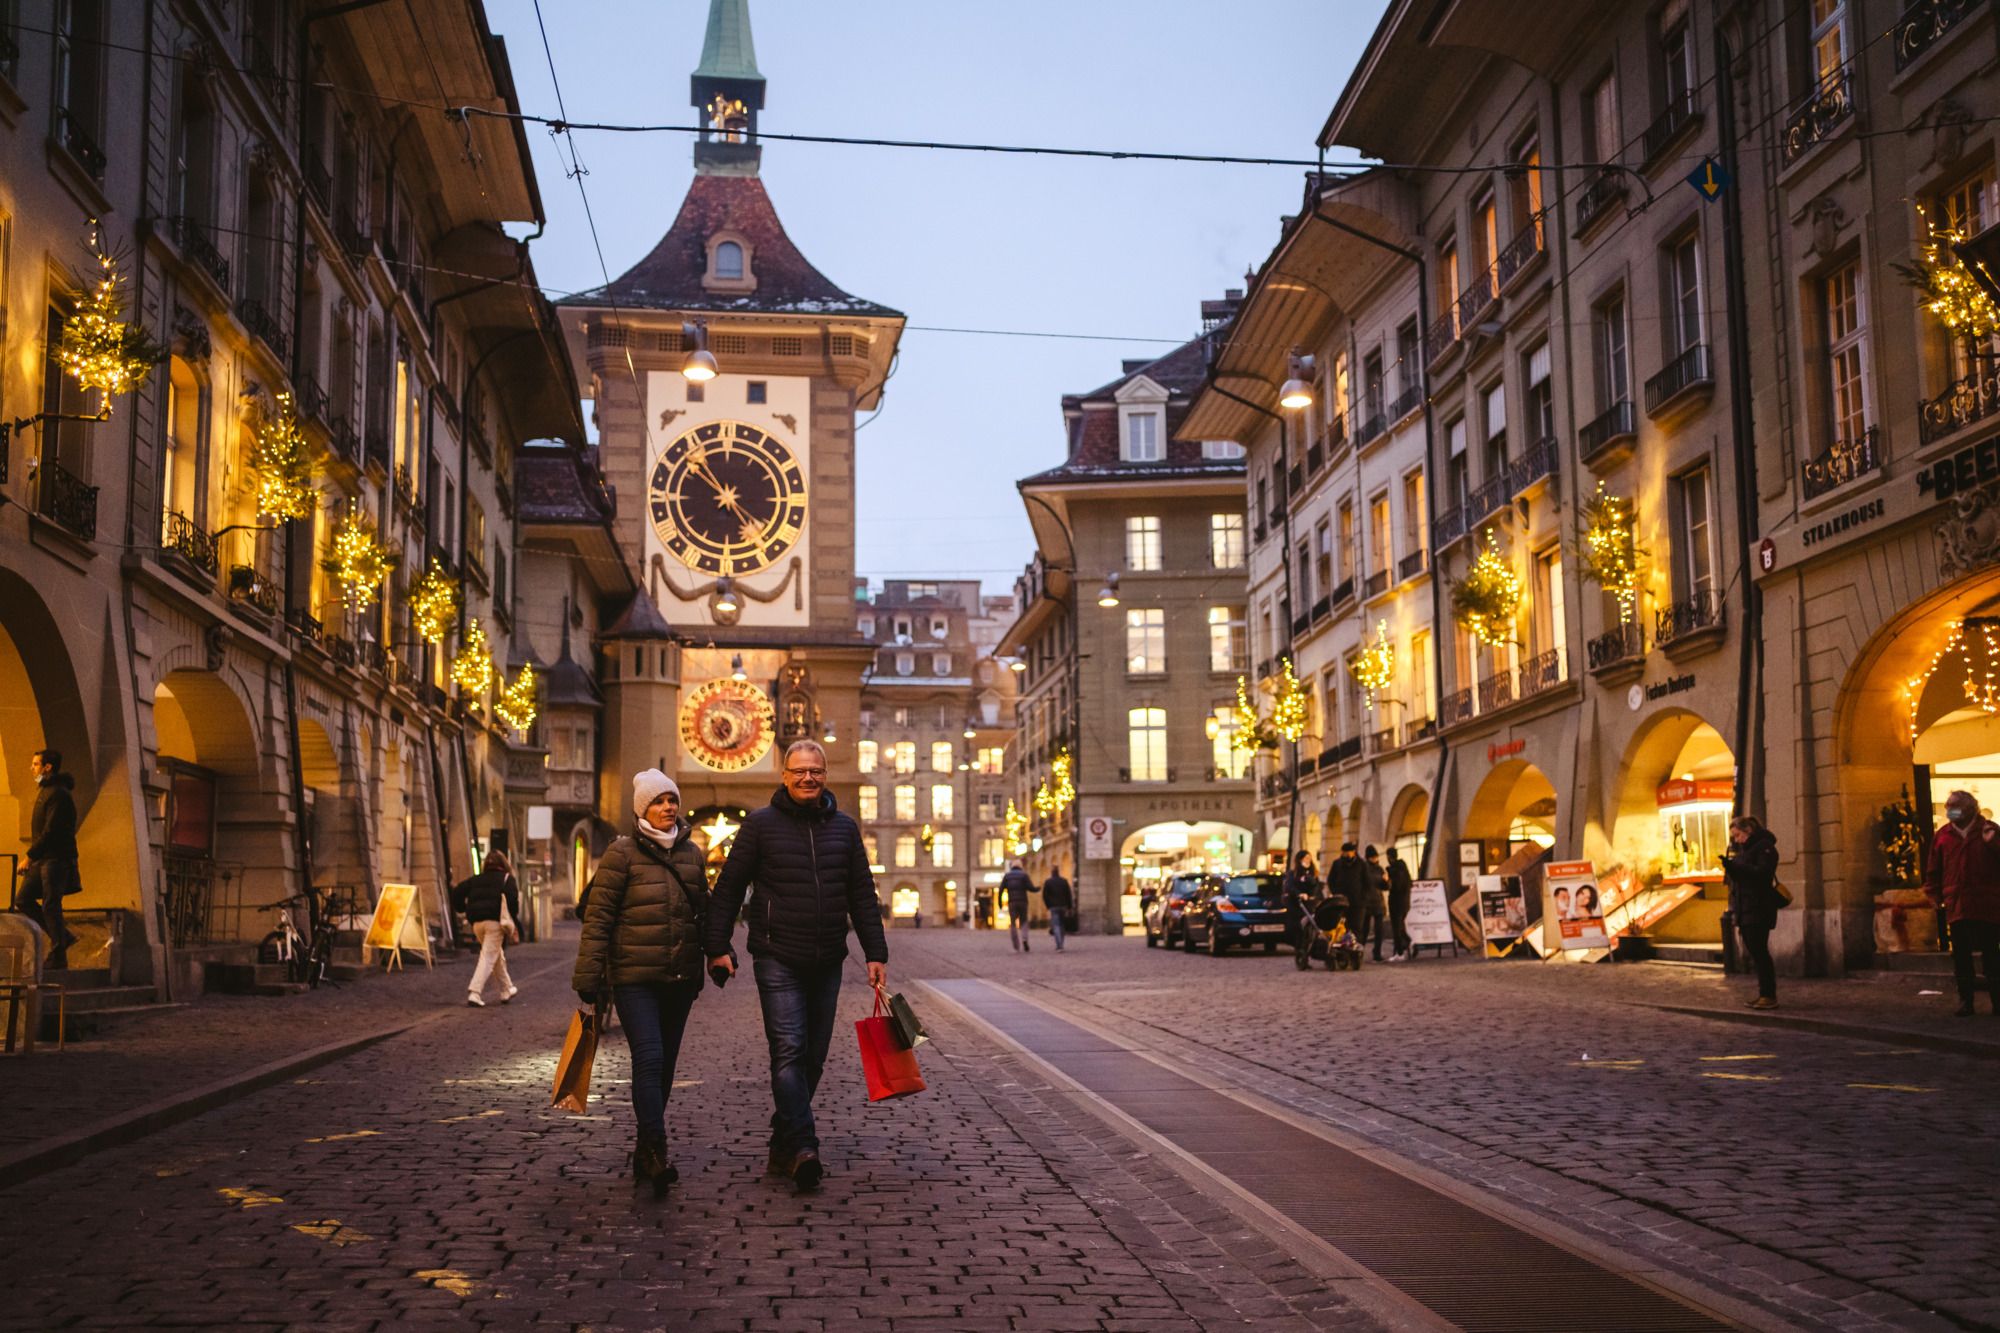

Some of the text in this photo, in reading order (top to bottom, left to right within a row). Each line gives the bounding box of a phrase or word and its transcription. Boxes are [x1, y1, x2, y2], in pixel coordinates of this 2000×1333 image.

[1934, 435, 2000, 500] BEE
[1802, 497, 1884, 547] STEAKHOUSE
[1148, 798, 1234, 811] APOTHEKE
